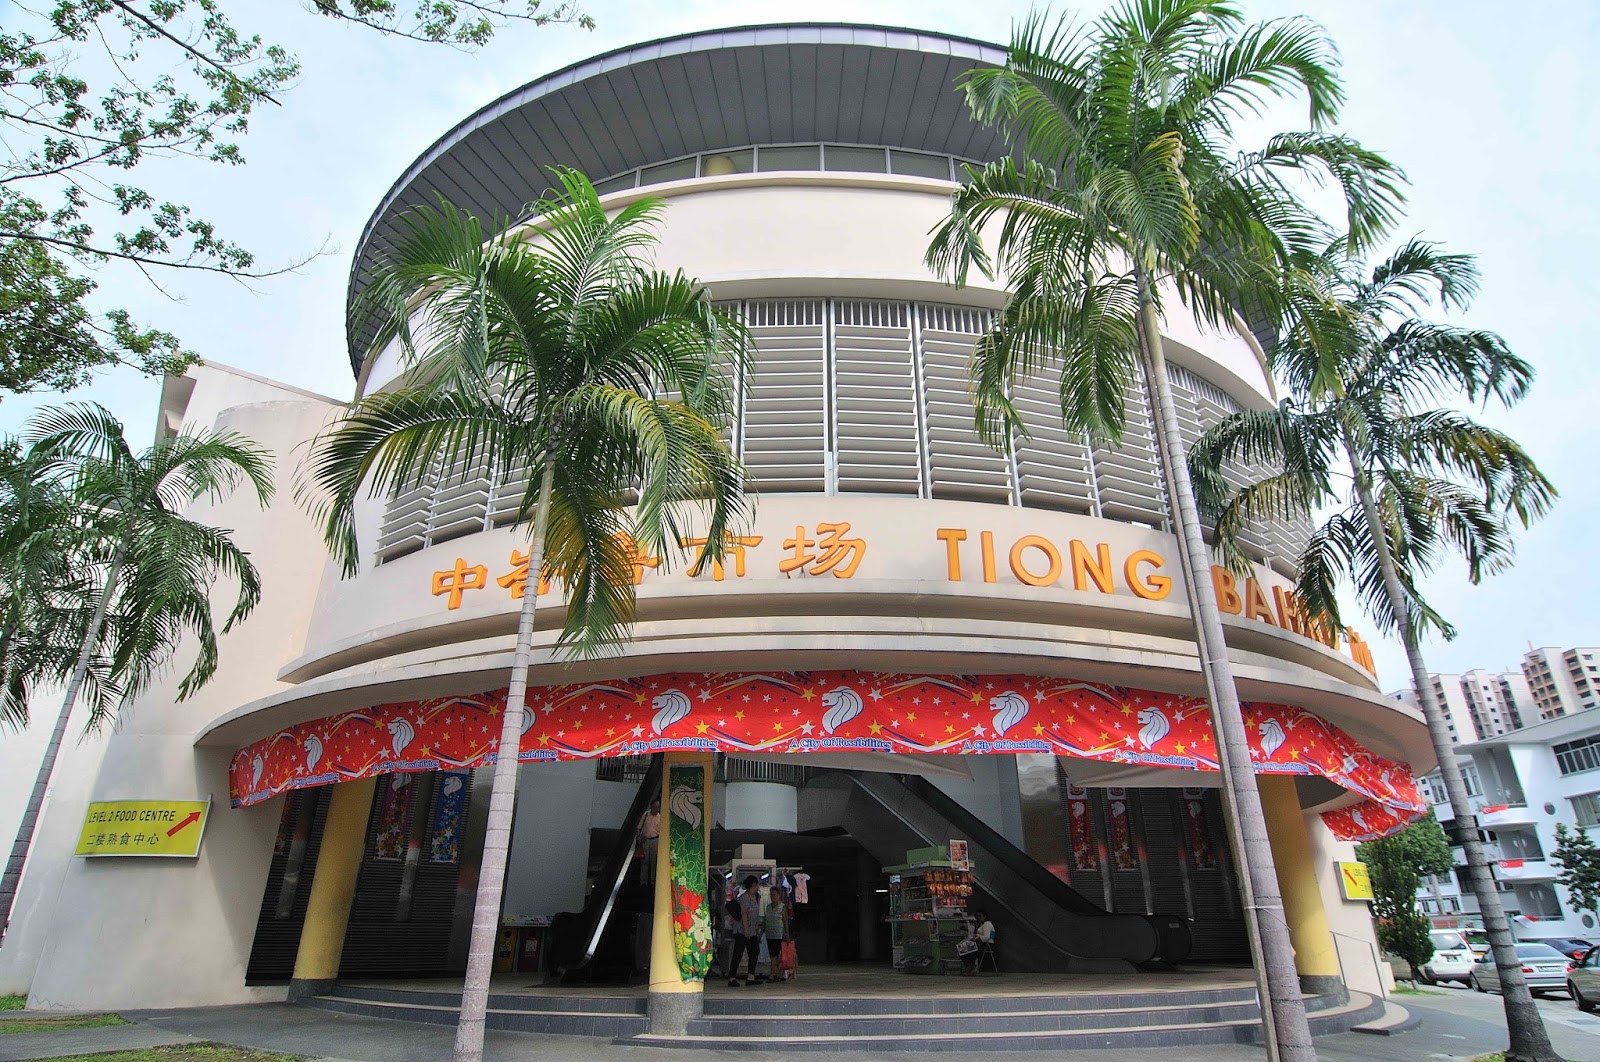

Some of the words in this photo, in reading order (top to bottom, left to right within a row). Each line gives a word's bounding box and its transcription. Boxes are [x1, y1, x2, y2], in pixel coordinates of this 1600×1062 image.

[936, 528, 1172, 600] TIONG
[800, 738, 820, 751] City
[836, 737, 892, 749] Possibilities
[88, 811, 107, 824] LEVEL
[108, 811, 114, 822] 2
[114, 810, 138, 822] FOOD
[139, 810, 176, 822] CENTRE
